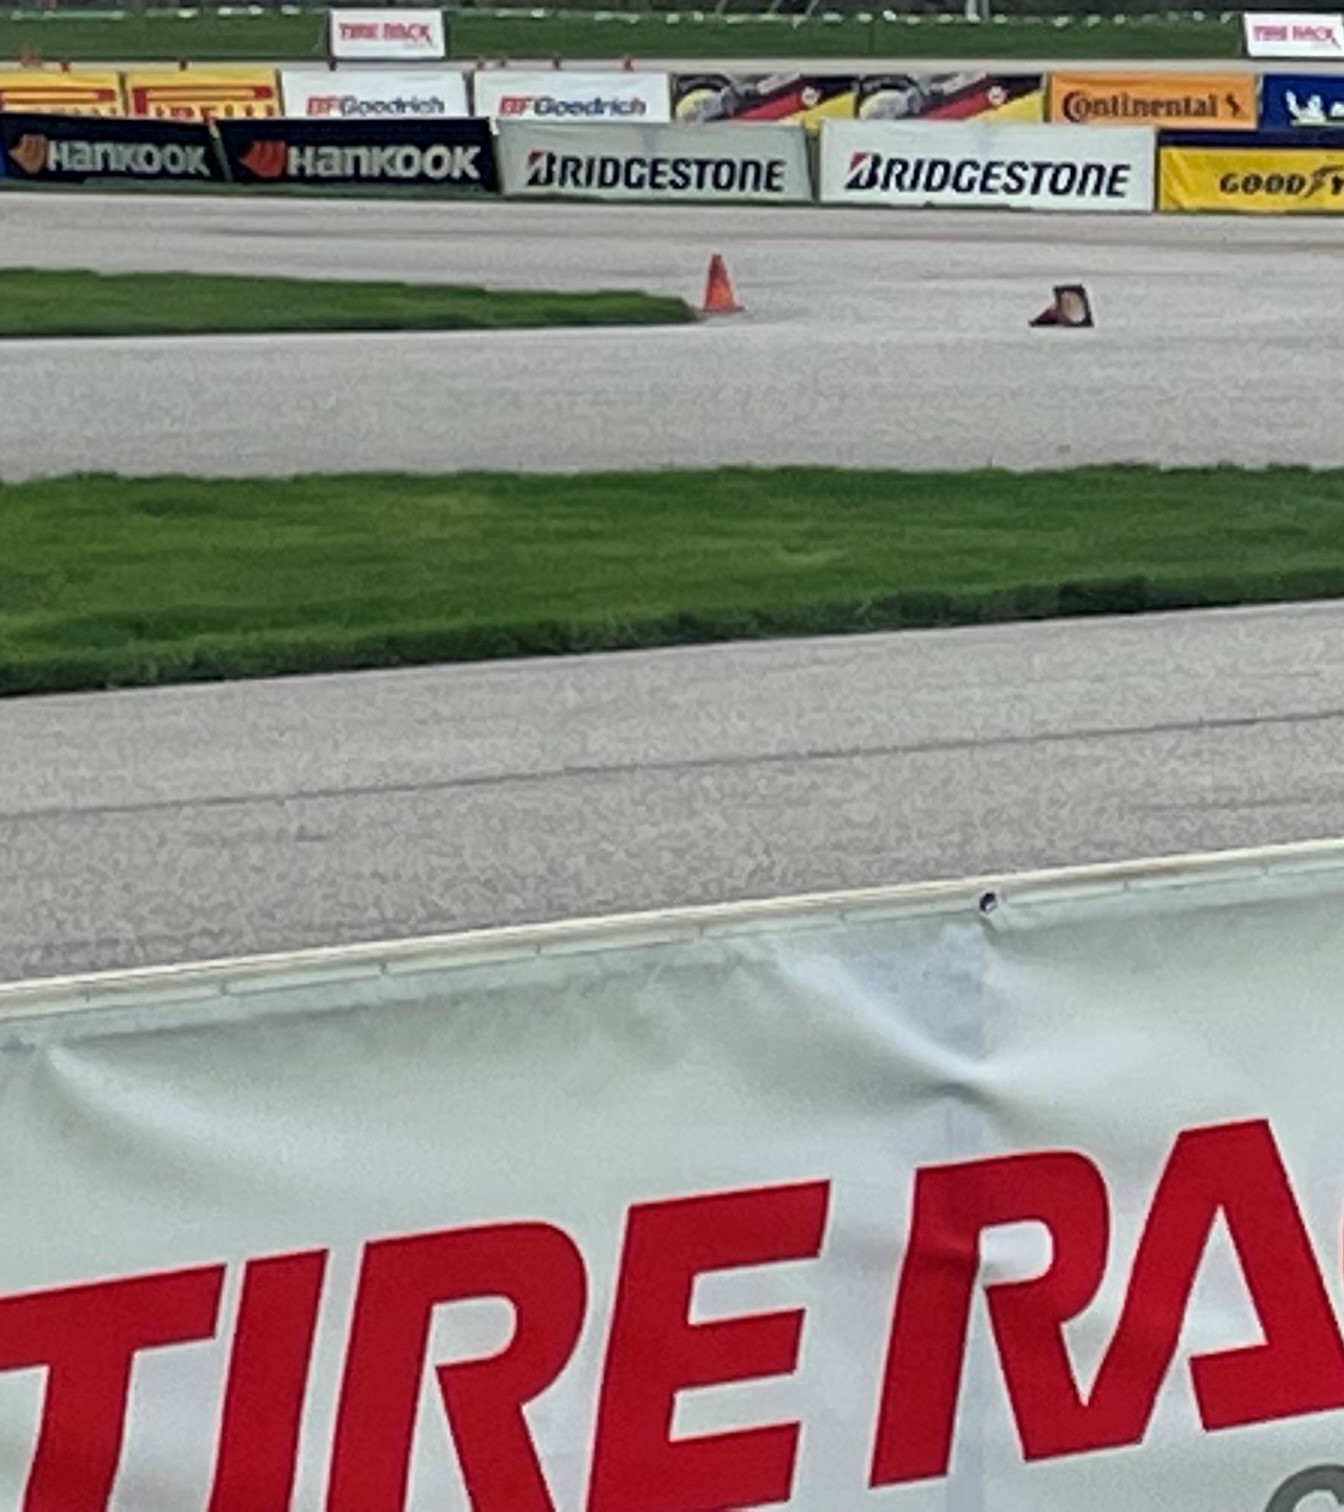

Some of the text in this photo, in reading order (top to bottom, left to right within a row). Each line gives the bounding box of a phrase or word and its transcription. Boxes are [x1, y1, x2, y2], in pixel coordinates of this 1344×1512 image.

[1063, 89, 1218, 122] Continental
[525, 151, 785, 191] BRIDGESTONE
[845, 153, 1132, 199] BRIDGESTONE
[0, 1179, 832, 1512] TIRE
